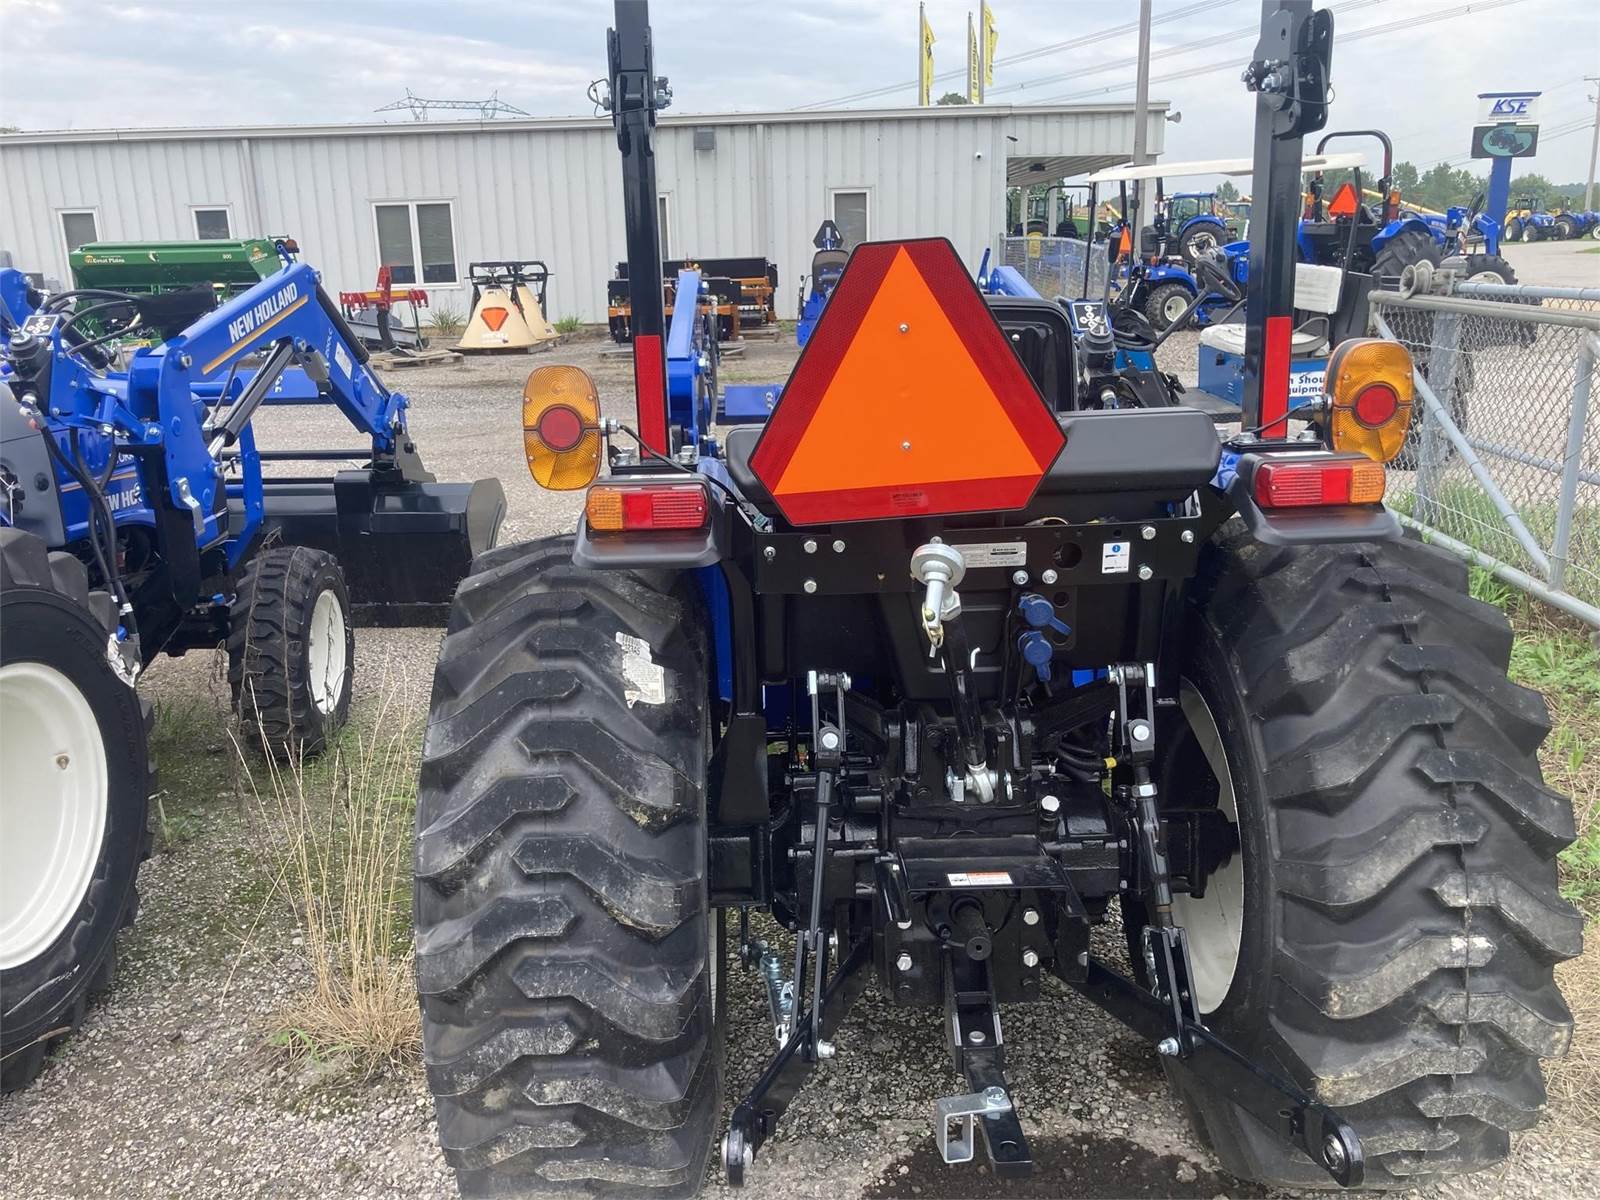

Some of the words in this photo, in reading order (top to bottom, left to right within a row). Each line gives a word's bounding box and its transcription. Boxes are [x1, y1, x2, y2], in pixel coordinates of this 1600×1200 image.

[1491, 98, 1530, 114] KSE
[228, 310, 255, 343] NEW
[254, 282, 298, 326] HOLLAND
